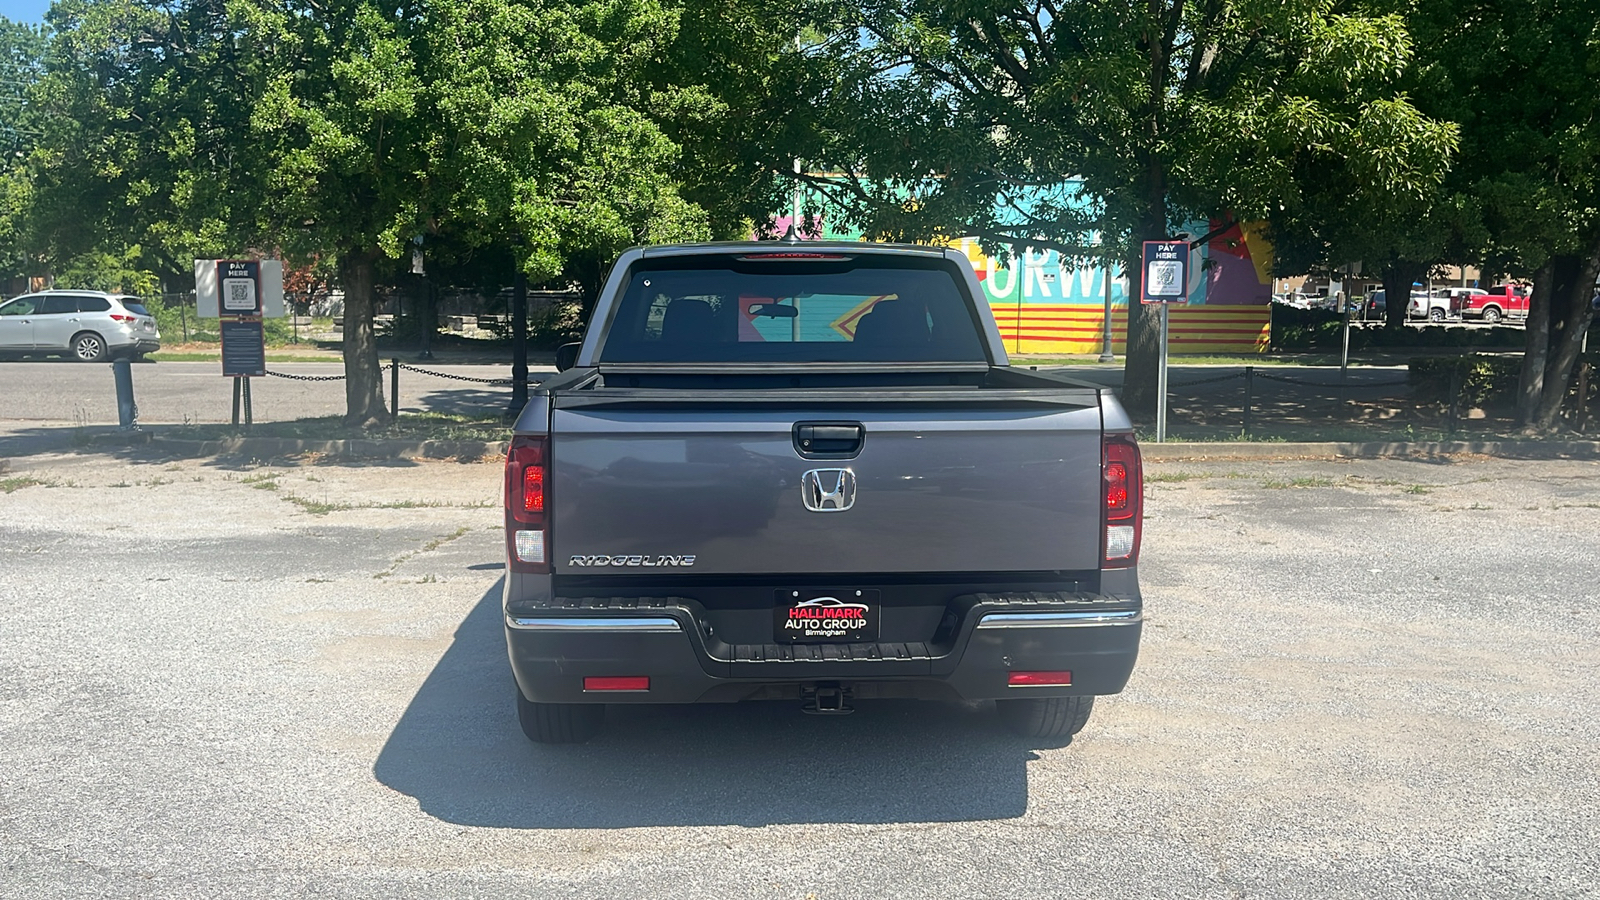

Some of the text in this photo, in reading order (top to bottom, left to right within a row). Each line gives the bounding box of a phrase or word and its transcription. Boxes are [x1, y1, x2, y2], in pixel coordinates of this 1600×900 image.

[961, 232, 1203, 298] FORWAD
[568, 554, 697, 567] RIDGELINE
[789, 608, 863, 619] HALLMARK
[784, 619, 867, 629] AUTO GROUP
[805, 629, 846, 637] Birmingham
